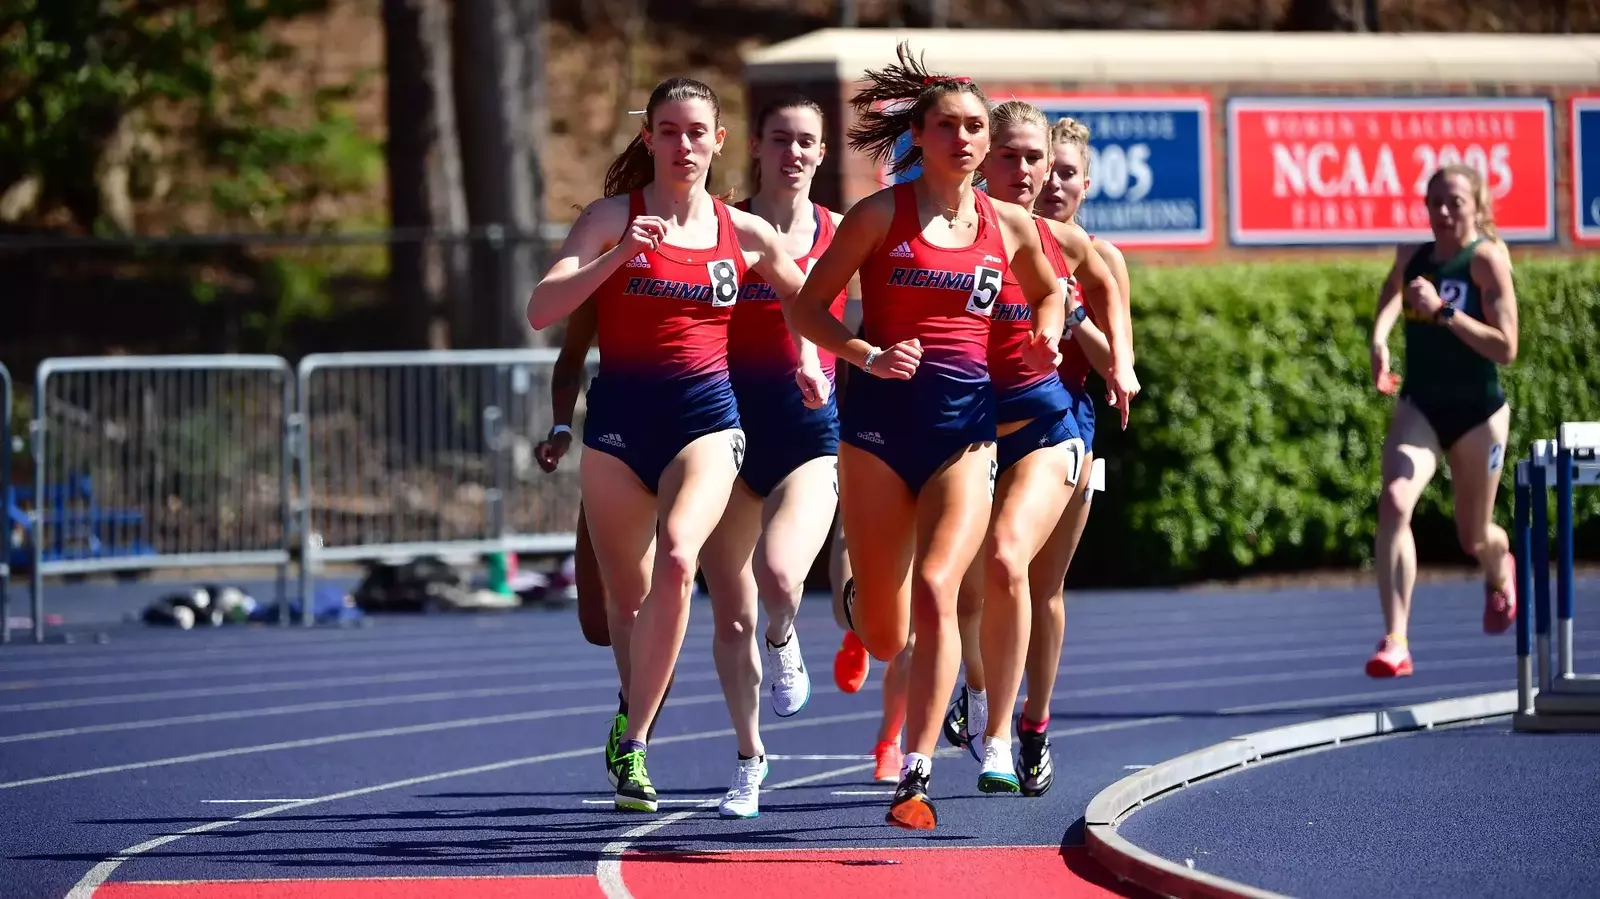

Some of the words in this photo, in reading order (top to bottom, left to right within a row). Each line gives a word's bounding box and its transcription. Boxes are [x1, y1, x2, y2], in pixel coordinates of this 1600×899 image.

[1271, 141, 1403, 198] NCAA
[625, 260, 652, 269] adidas
[888, 250, 915, 259] adidas
[712, 261, 738, 303] 8
[972, 268, 1000, 310] 5
[598, 435, 627, 449] adidas
